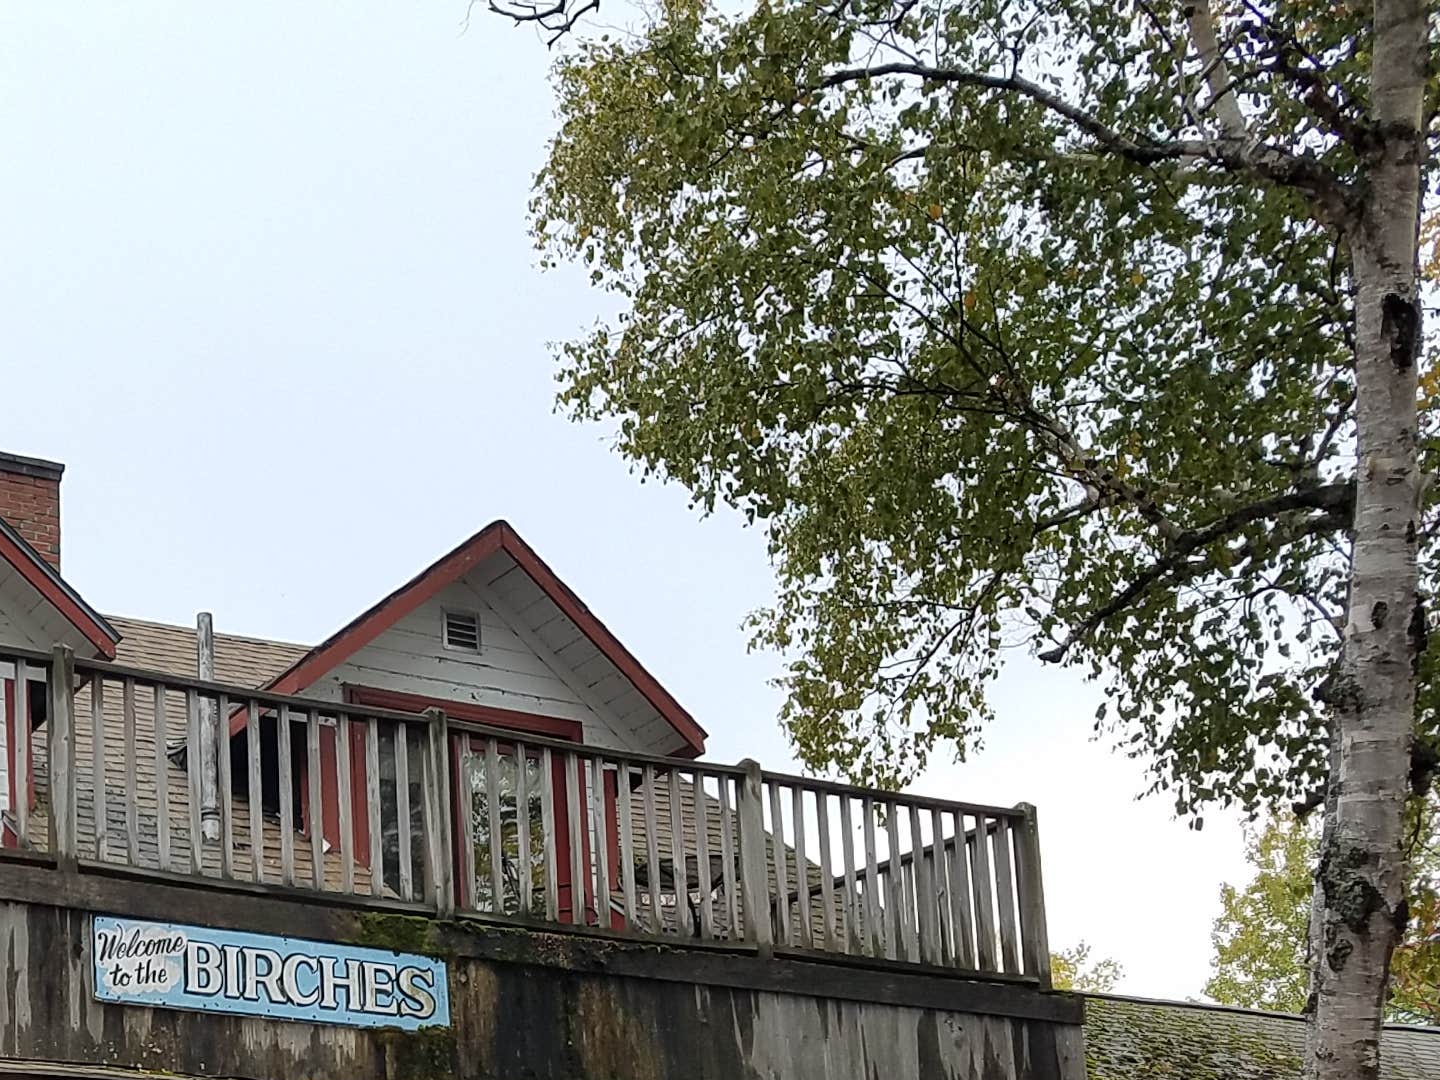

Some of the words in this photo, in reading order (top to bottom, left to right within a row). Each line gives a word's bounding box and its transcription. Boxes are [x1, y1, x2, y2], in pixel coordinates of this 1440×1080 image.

[98, 923, 185, 961] Welcome
[109, 963, 132, 987] to
[134, 959, 168, 985] the
[184, 939, 435, 1018] BIRCHES
